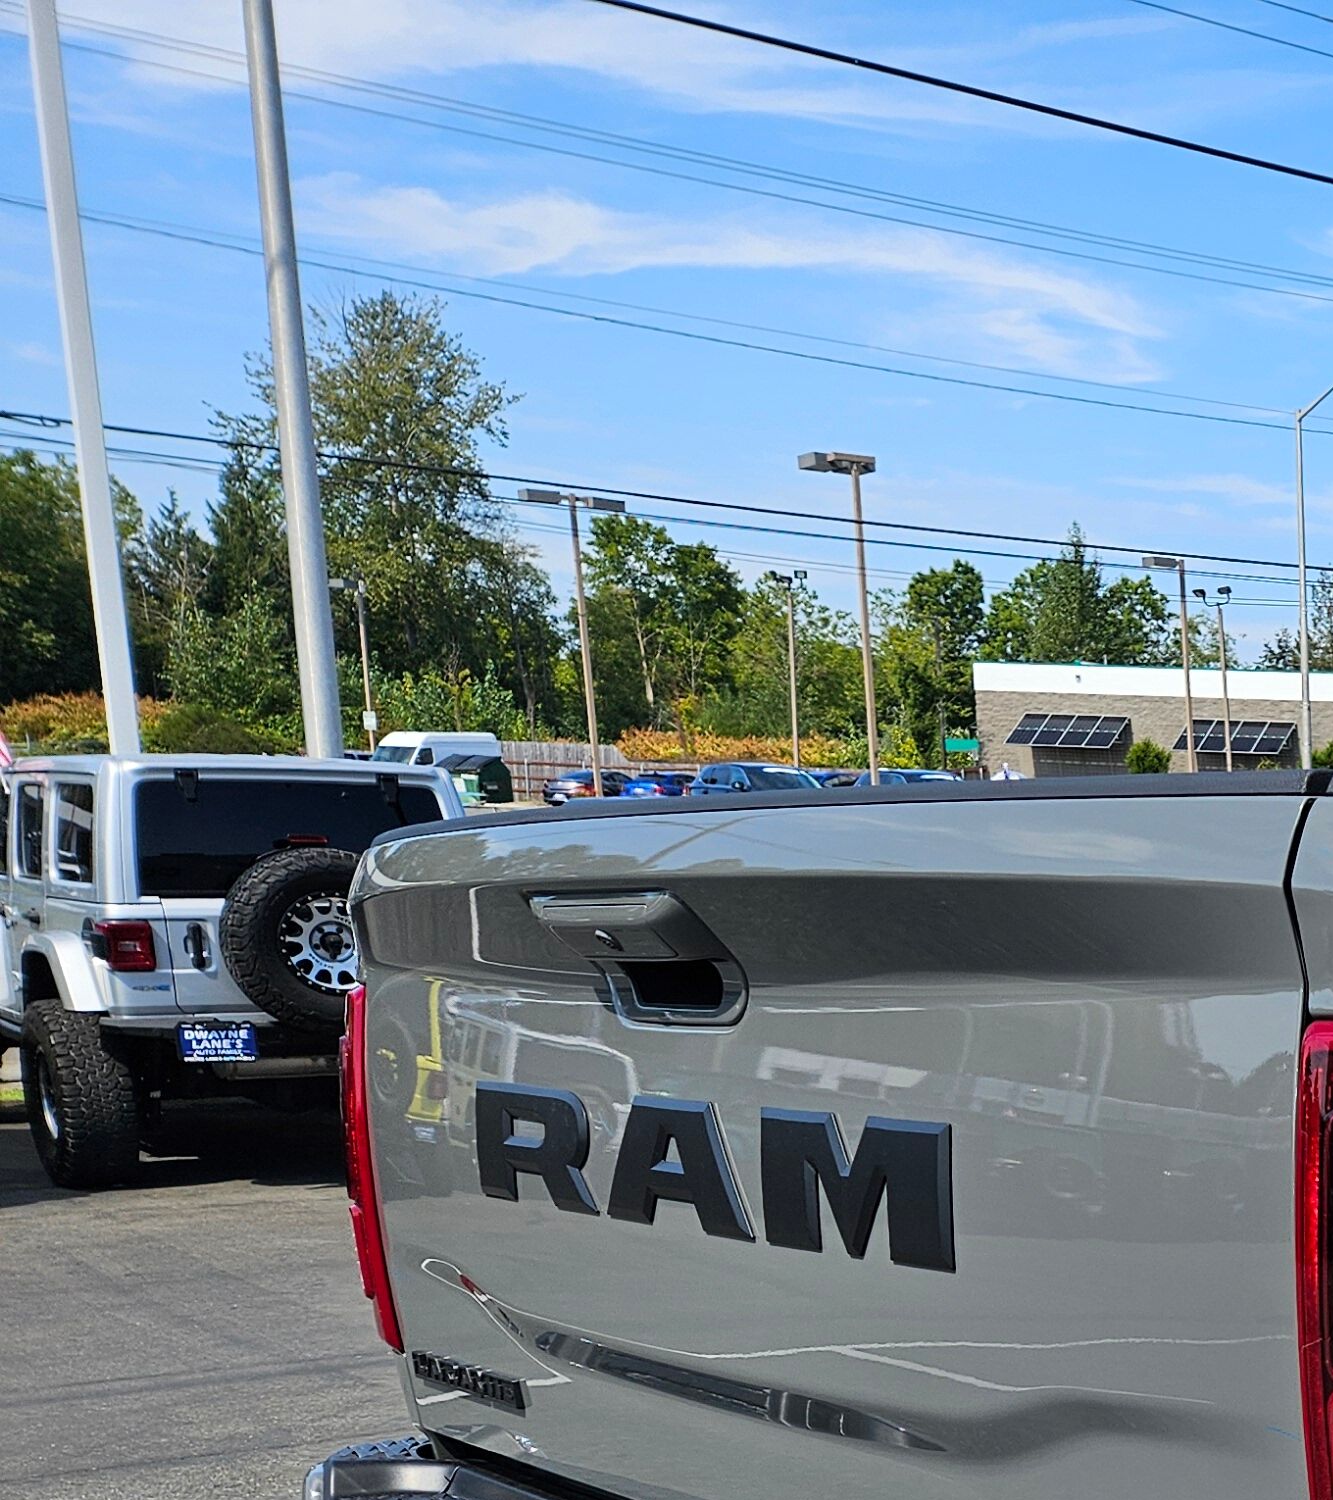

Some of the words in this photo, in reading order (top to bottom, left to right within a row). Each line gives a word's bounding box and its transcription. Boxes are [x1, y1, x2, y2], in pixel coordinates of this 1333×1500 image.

[184, 1029, 249, 1040] DWAYNE
[191, 1039, 244, 1049] LANE'S
[475, 1081, 957, 1272] RAM
